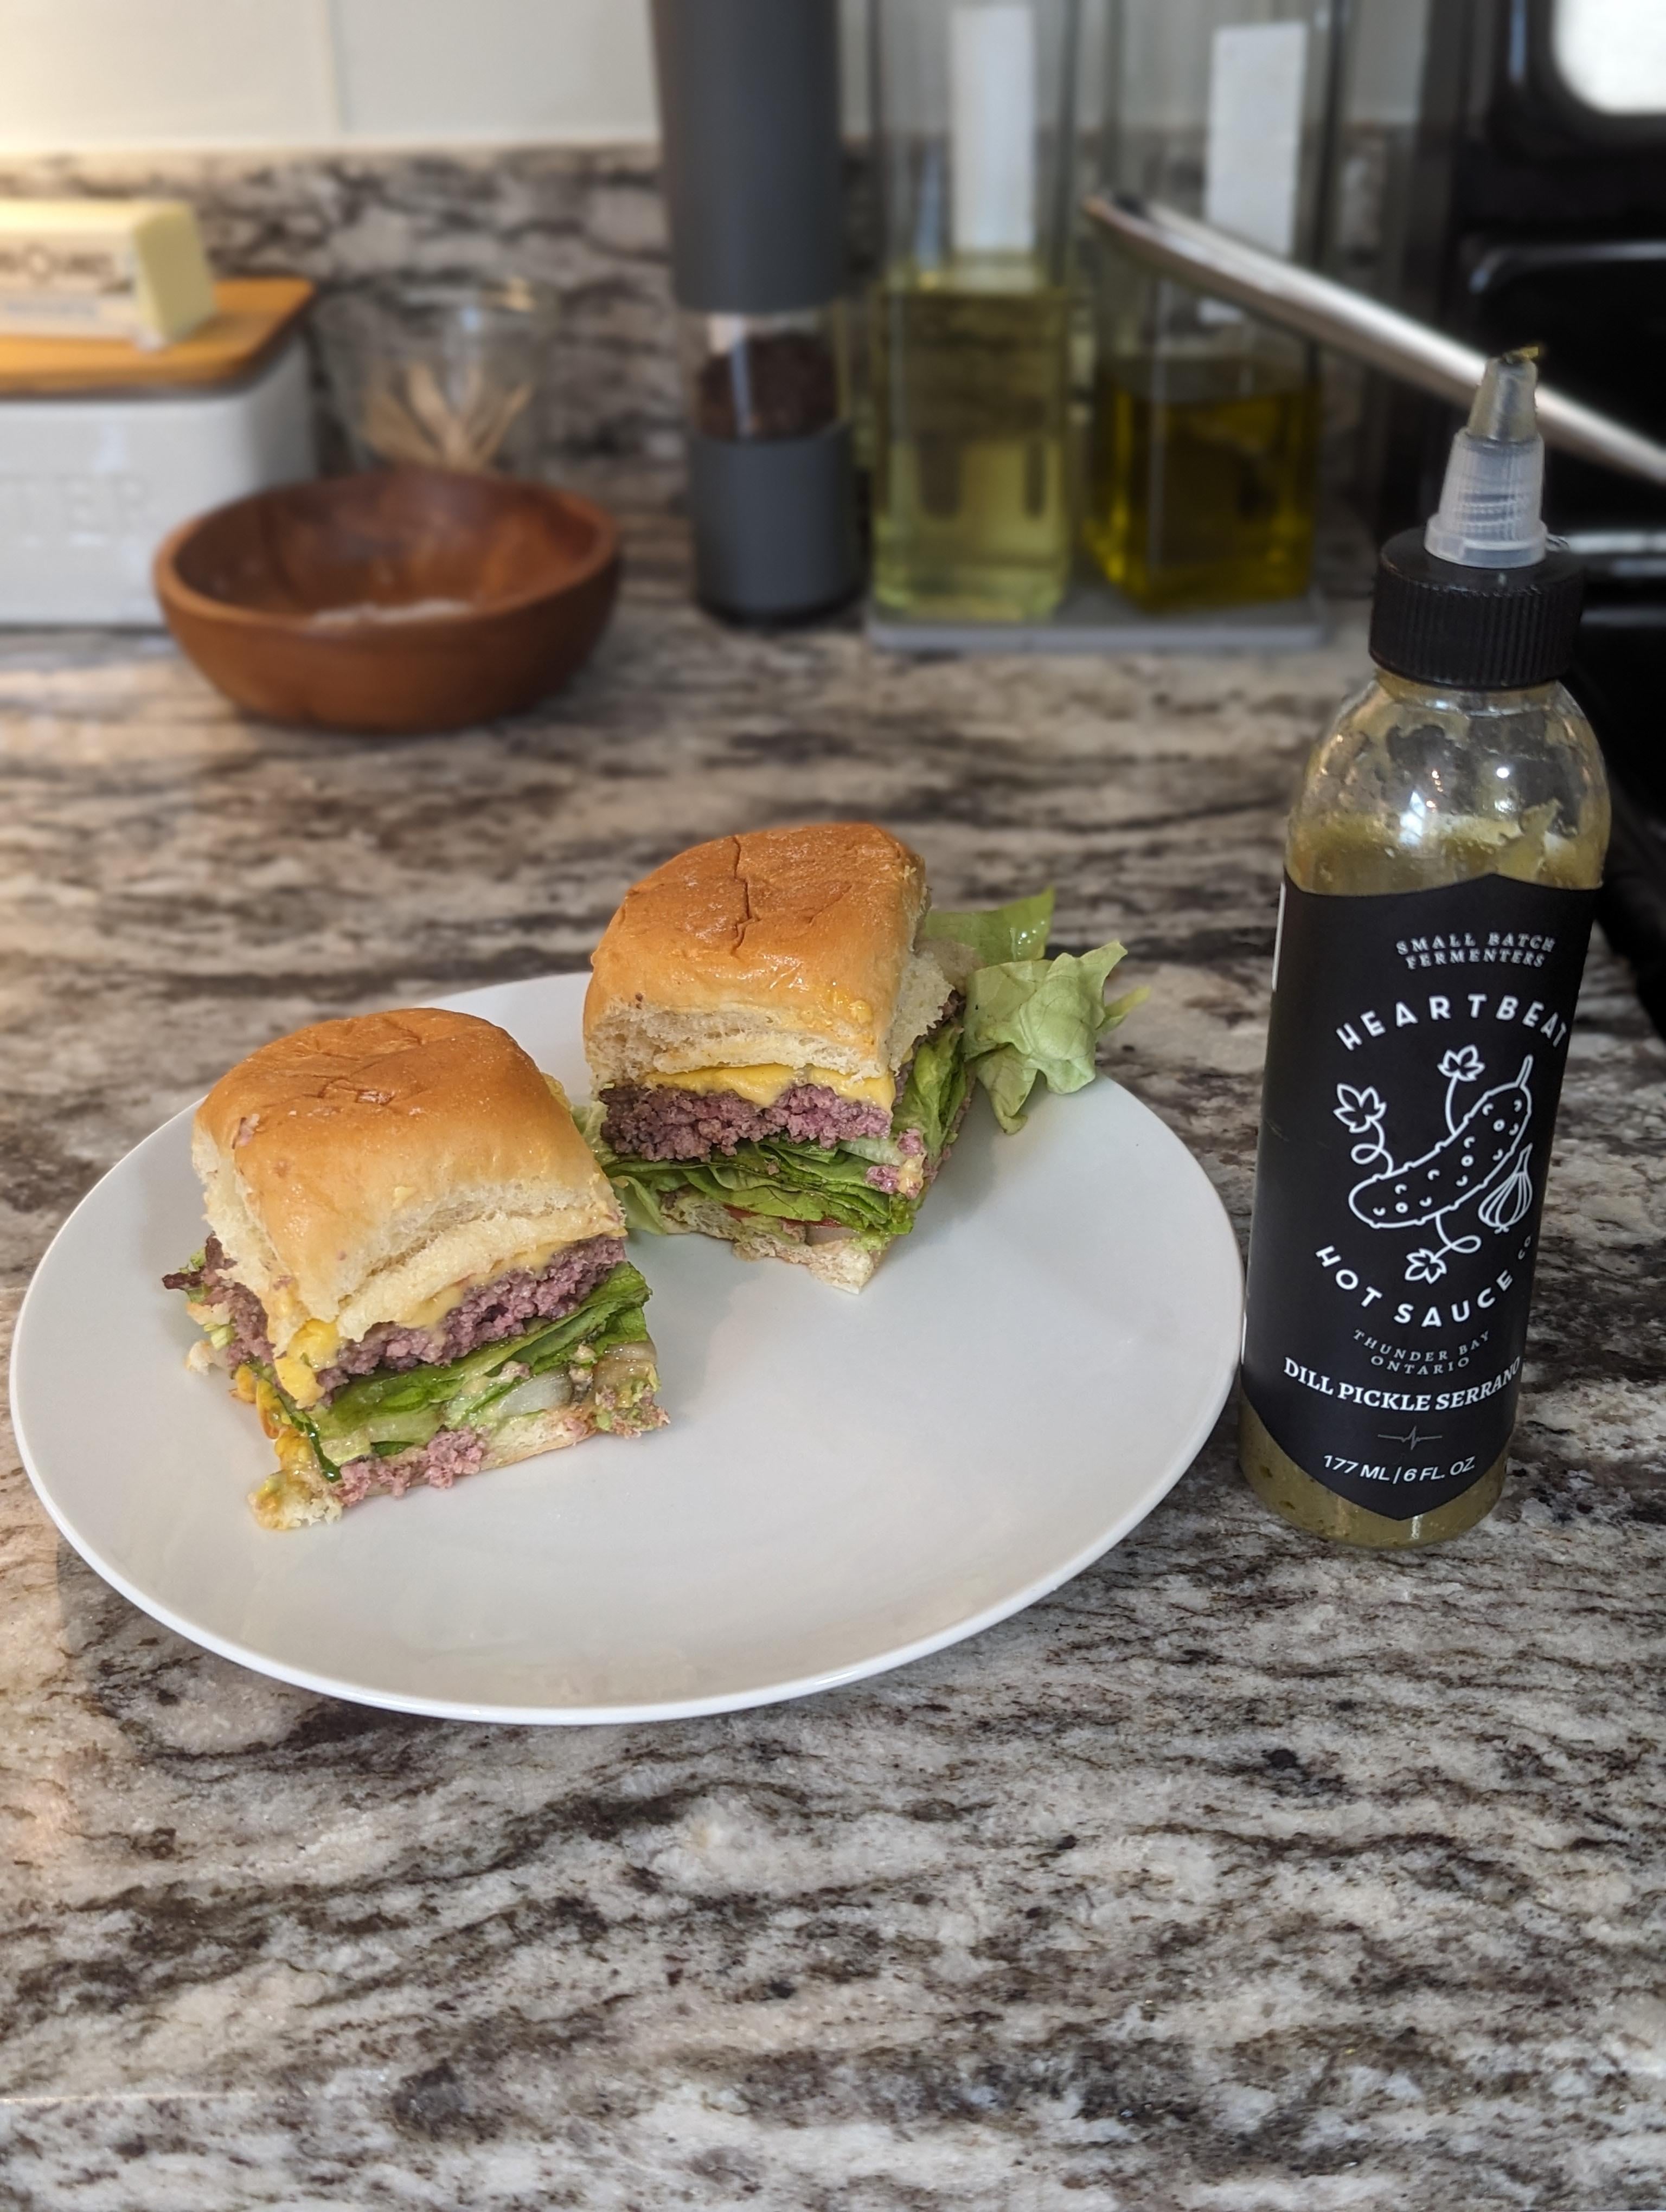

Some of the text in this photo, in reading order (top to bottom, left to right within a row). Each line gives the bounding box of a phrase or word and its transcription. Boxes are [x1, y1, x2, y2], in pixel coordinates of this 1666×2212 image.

[1396, 932, 1555, 955] SMALL BATCH
[1406, 949, 1545, 970] FERMENTERS
[1336, 994, 1567, 1051] HEARTBEAT
[1315, 1245, 1382, 1307] HOT
[1394, 1270, 1513, 1327] SAUCE
[1354, 1329, 1489, 1361] THUNDER BAY
[1371, 1355, 1469, 1375] ONTARIO
[1284, 1356, 1520, 1411] DILL PICKLE SERRANO
[1323, 1455, 1359, 1474] 177
[1419, 1467, 1445, 1481] FL.
[1450, 1456, 1475, 1475] OZ
